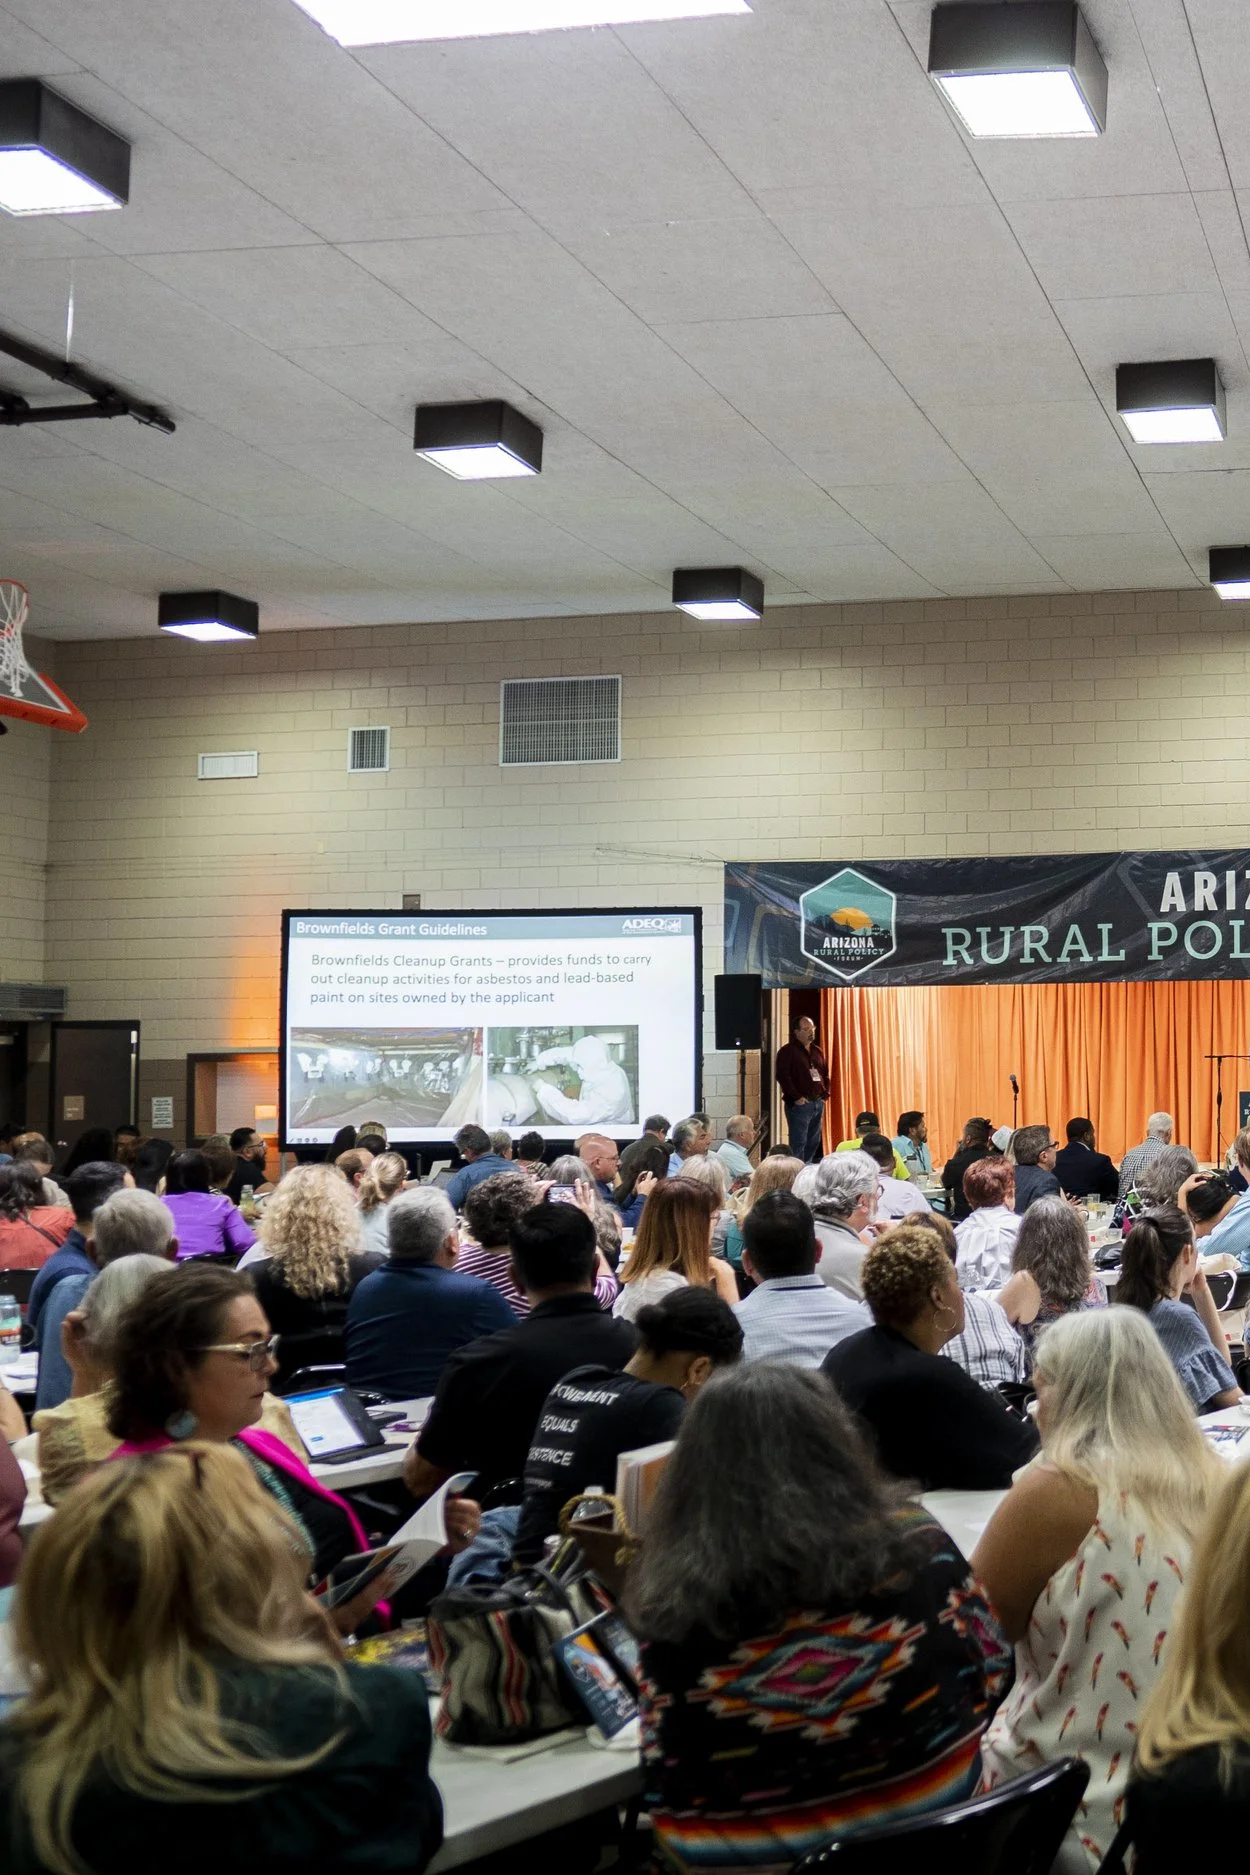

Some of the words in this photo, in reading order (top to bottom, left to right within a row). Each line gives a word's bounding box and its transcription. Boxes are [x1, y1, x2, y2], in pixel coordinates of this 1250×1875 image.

[297, 922, 375, 935] Brownfields
[378, 923, 416, 936] Grant
[419, 923, 487, 936] Guidelines
[622, 918, 664, 930] ADEQ
[823, 937, 874, 949] ARIZONA
[942, 923, 1125, 966] RURAL
[312, 954, 389, 967] Brownfields
[393, 955, 445, 969] Cleanup
[450, 956, 492, 967] Grants
[508, 955, 562, 969] provides
[568, 954, 602, 966] funds
[607, 954, 620, 965] to
[624, 956, 651, 967] carry
[311, 974, 333, 985] out
[337, 973, 388, 987] cleanup
[393, 973, 449, 985] activities
[454, 973, 472, 985] for
[476, 973, 532, 985] asbestos
[536, 973, 559, 985] and
[564, 971, 633, 984] lead-based
[311, 993, 344, 1005] paint
[348, 994, 364, 1004] on
[369, 992, 398, 1004] sites
[403, 992, 446, 1004] owned
[451, 992, 466, 1006] by
[471, 992, 491, 1004] the
[495, 992, 554, 1006] applicant
[541, 1414, 580, 1433] EQUALS
